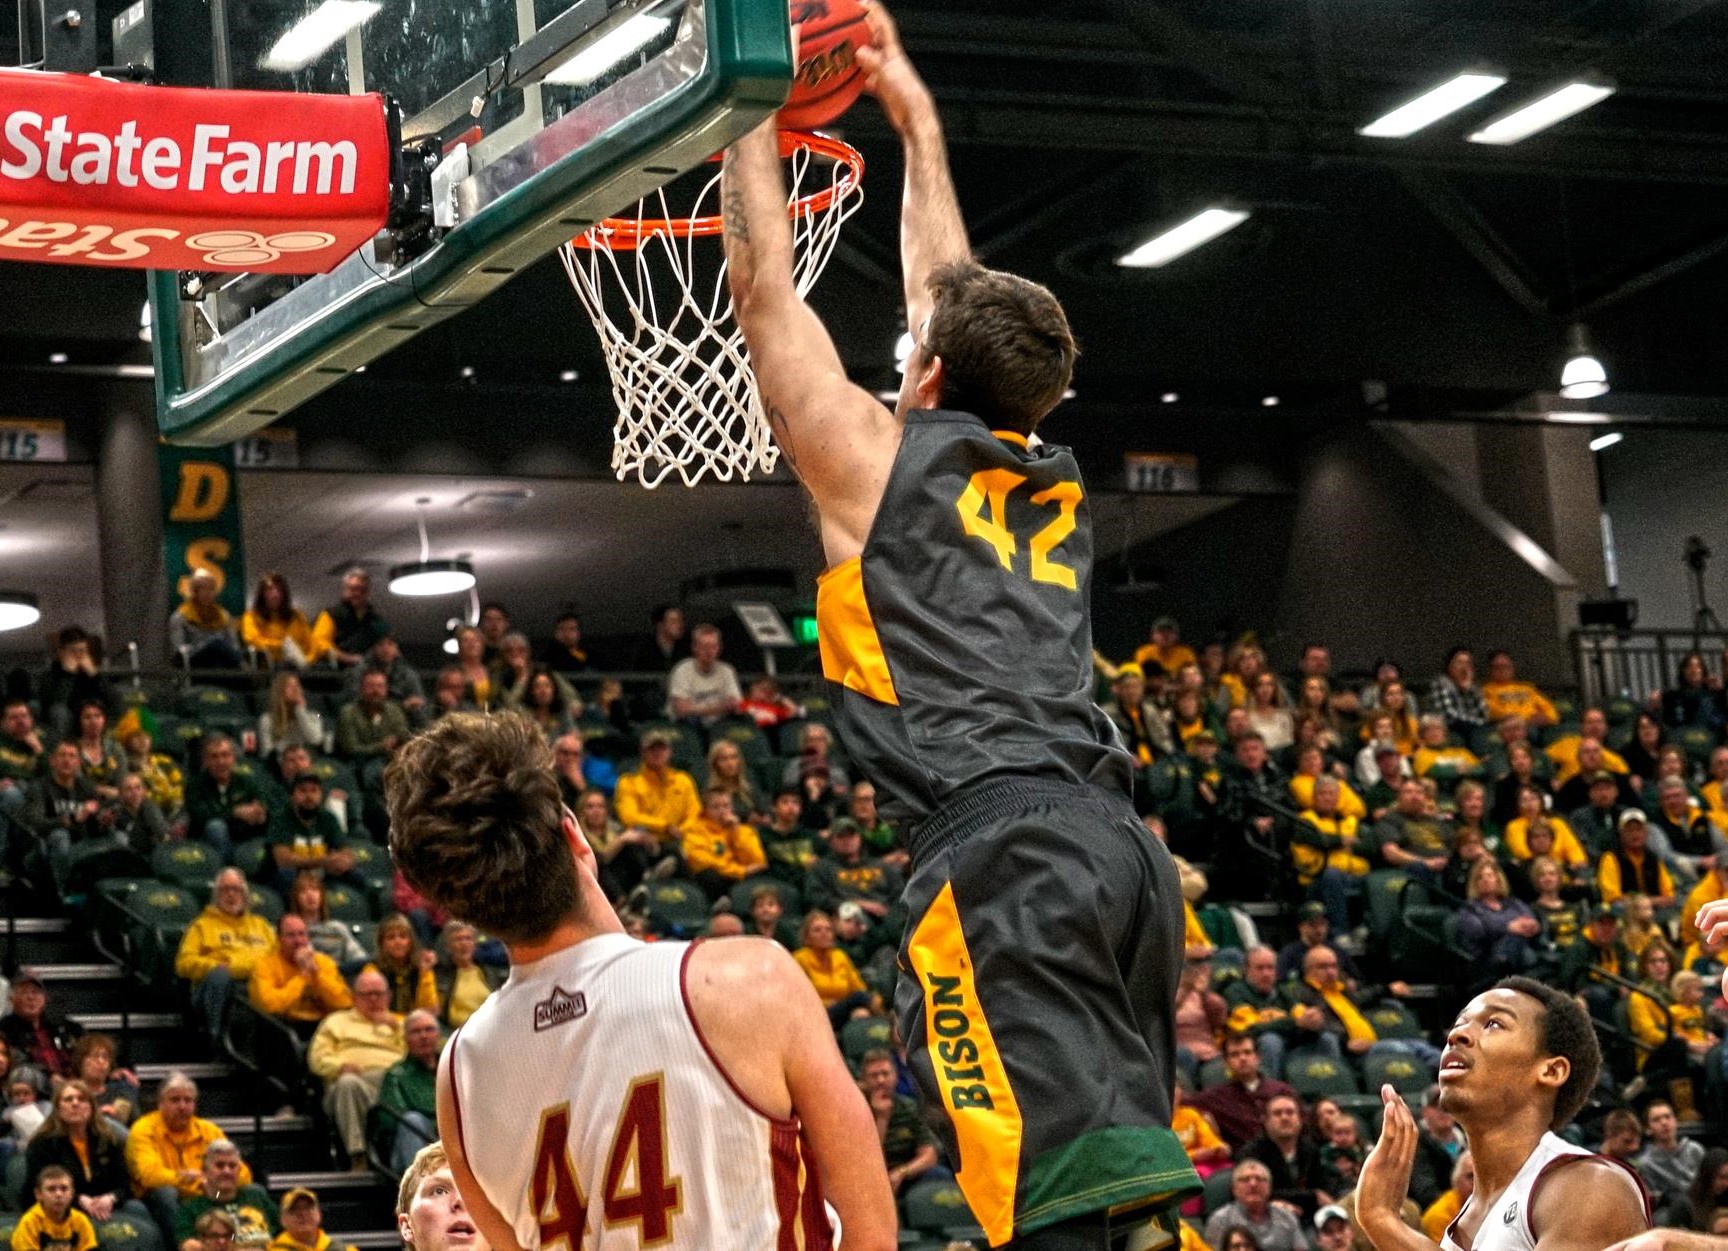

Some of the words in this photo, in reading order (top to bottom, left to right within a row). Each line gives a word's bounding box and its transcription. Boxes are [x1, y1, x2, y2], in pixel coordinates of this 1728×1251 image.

[0, 218, 181, 261] Sta
[956, 468, 1083, 591] 42
[927, 972, 995, 1111] BISON
[528, 1070, 684, 1251] 44
